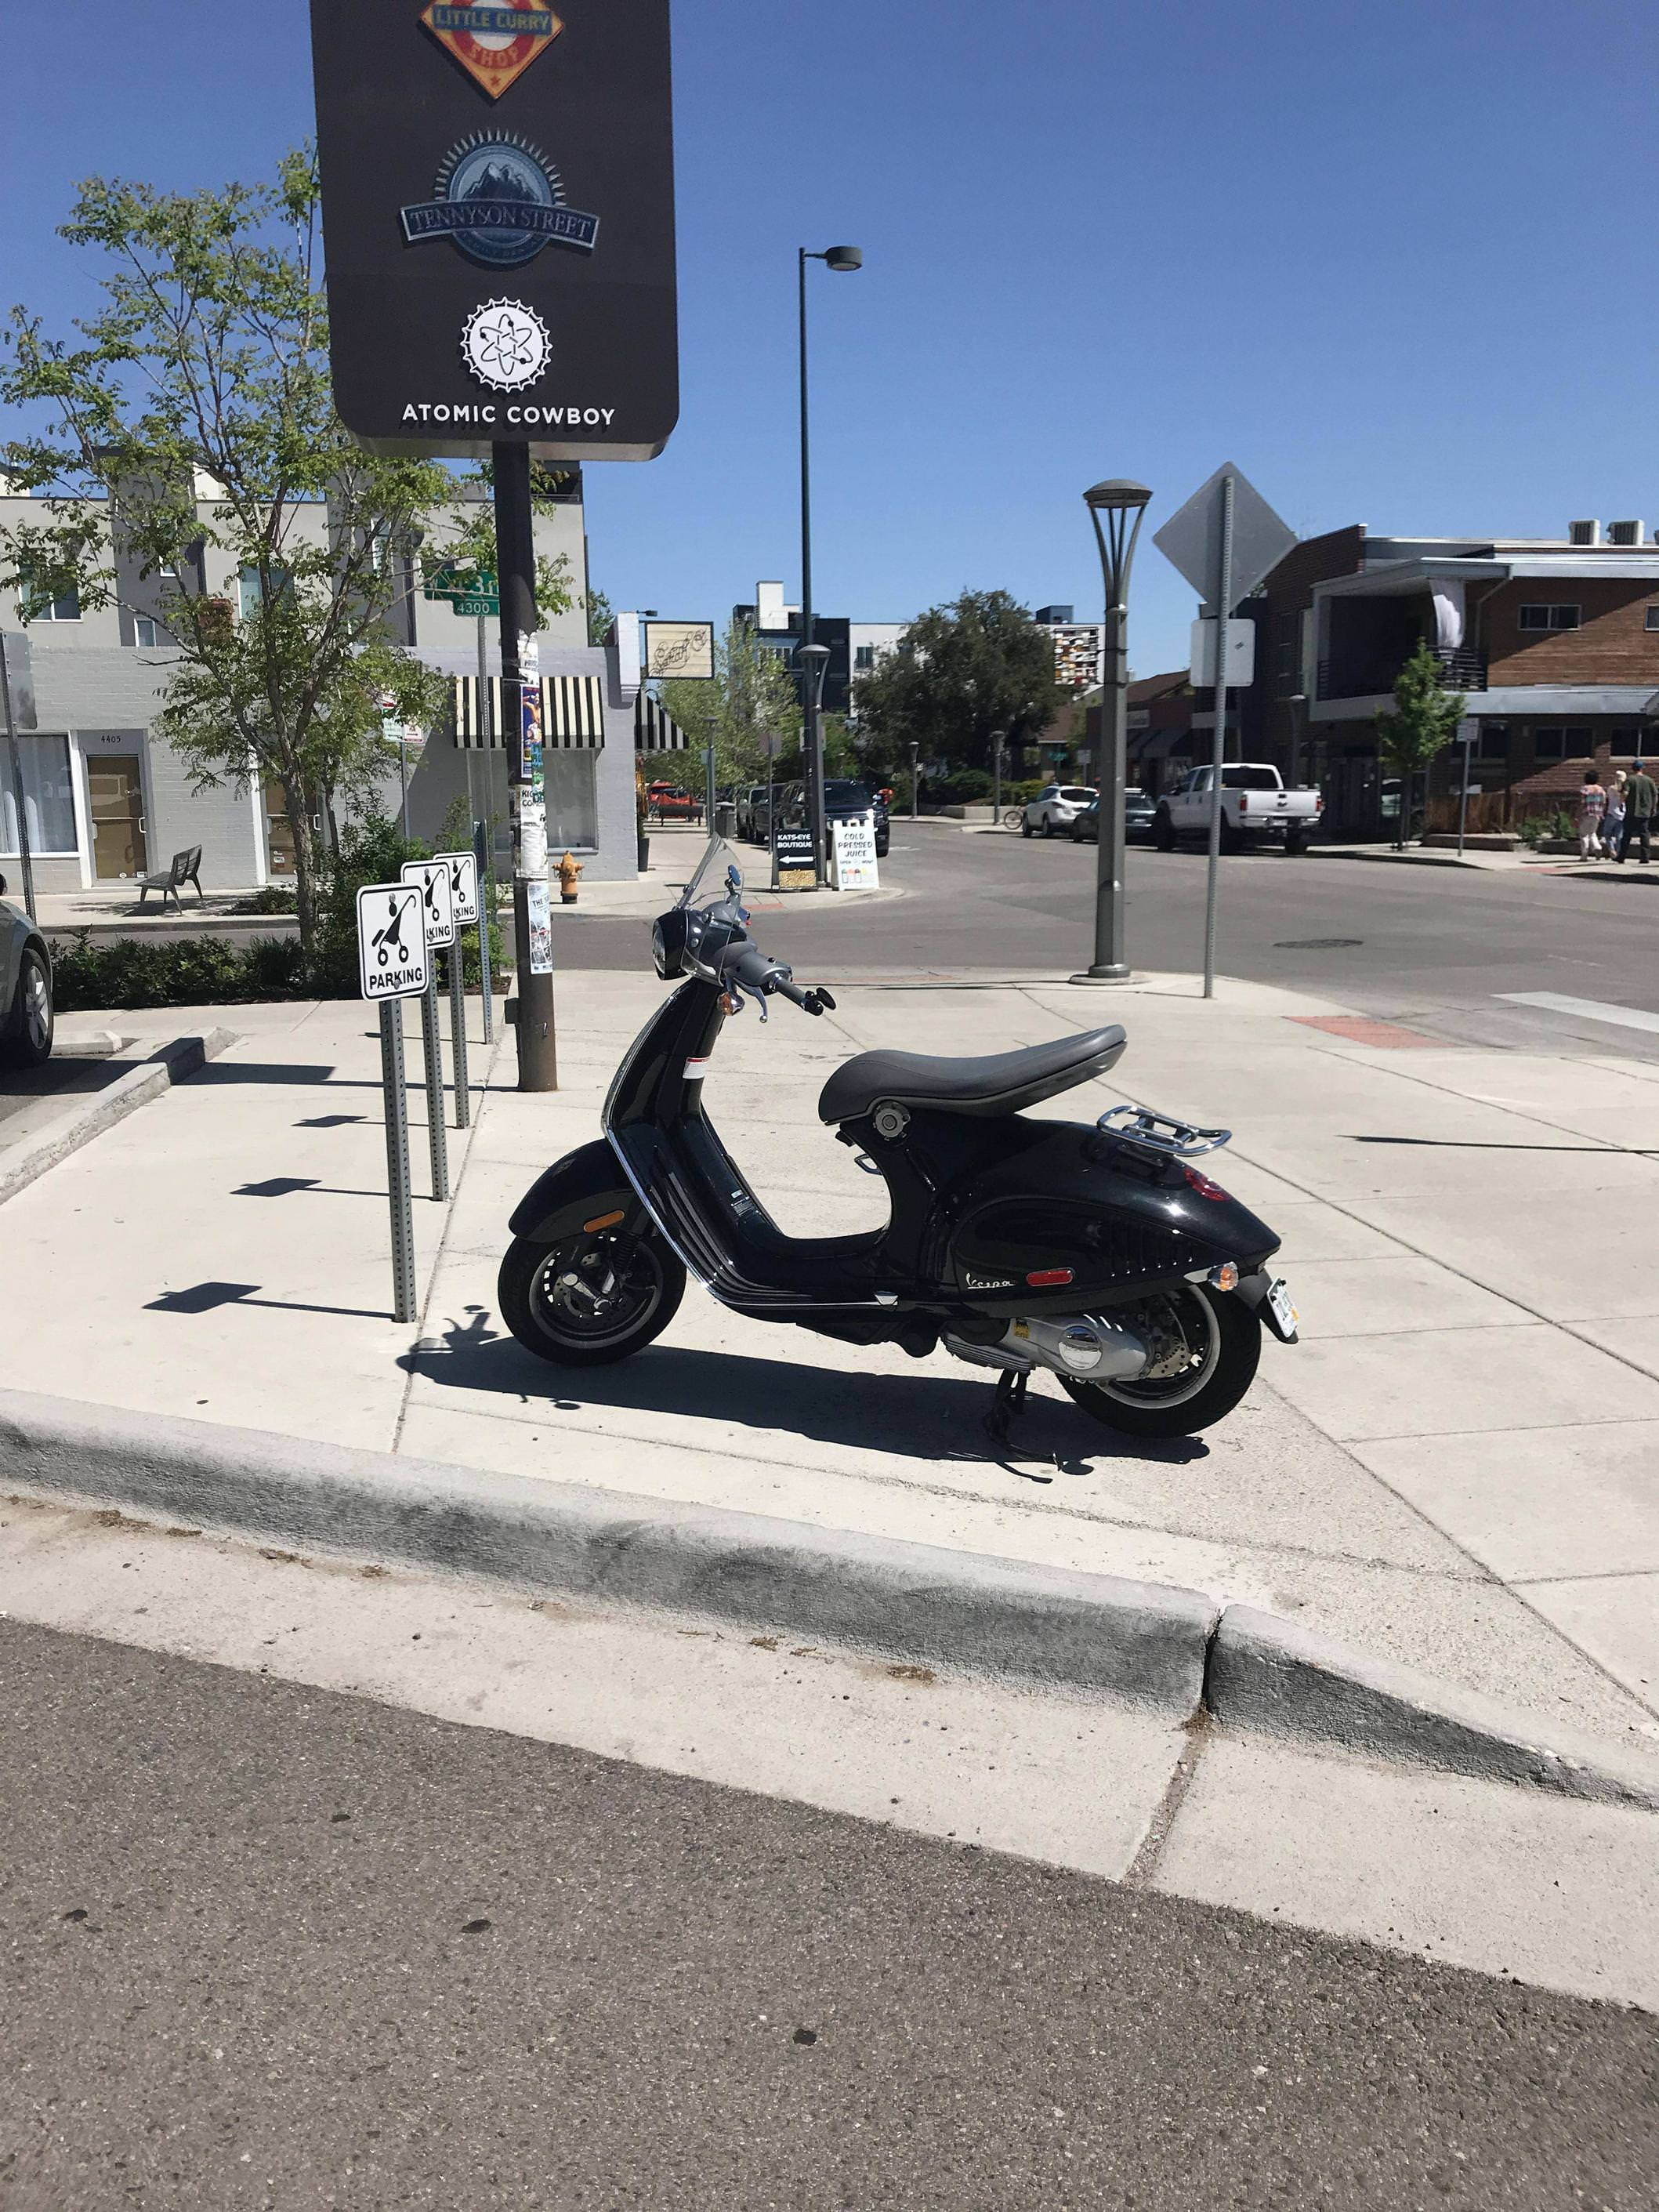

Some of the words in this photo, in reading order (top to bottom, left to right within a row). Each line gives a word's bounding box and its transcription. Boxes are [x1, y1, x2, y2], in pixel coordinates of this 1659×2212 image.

[436, 9, 490, 27] LITTLE
[496, 13, 549, 31] CURRY
[410, 205, 516, 231] TENNYSON
[521, 210, 591, 238] STREET
[402, 404, 496, 422] ATOMIC
[507, 406, 615, 425] COWBOY
[457, 602, 490, 614] 4300
[532, 899, 544, 908] THE
[369, 967, 422, 990] PARKING
[965, 1272, 1016, 1289] Vespa
